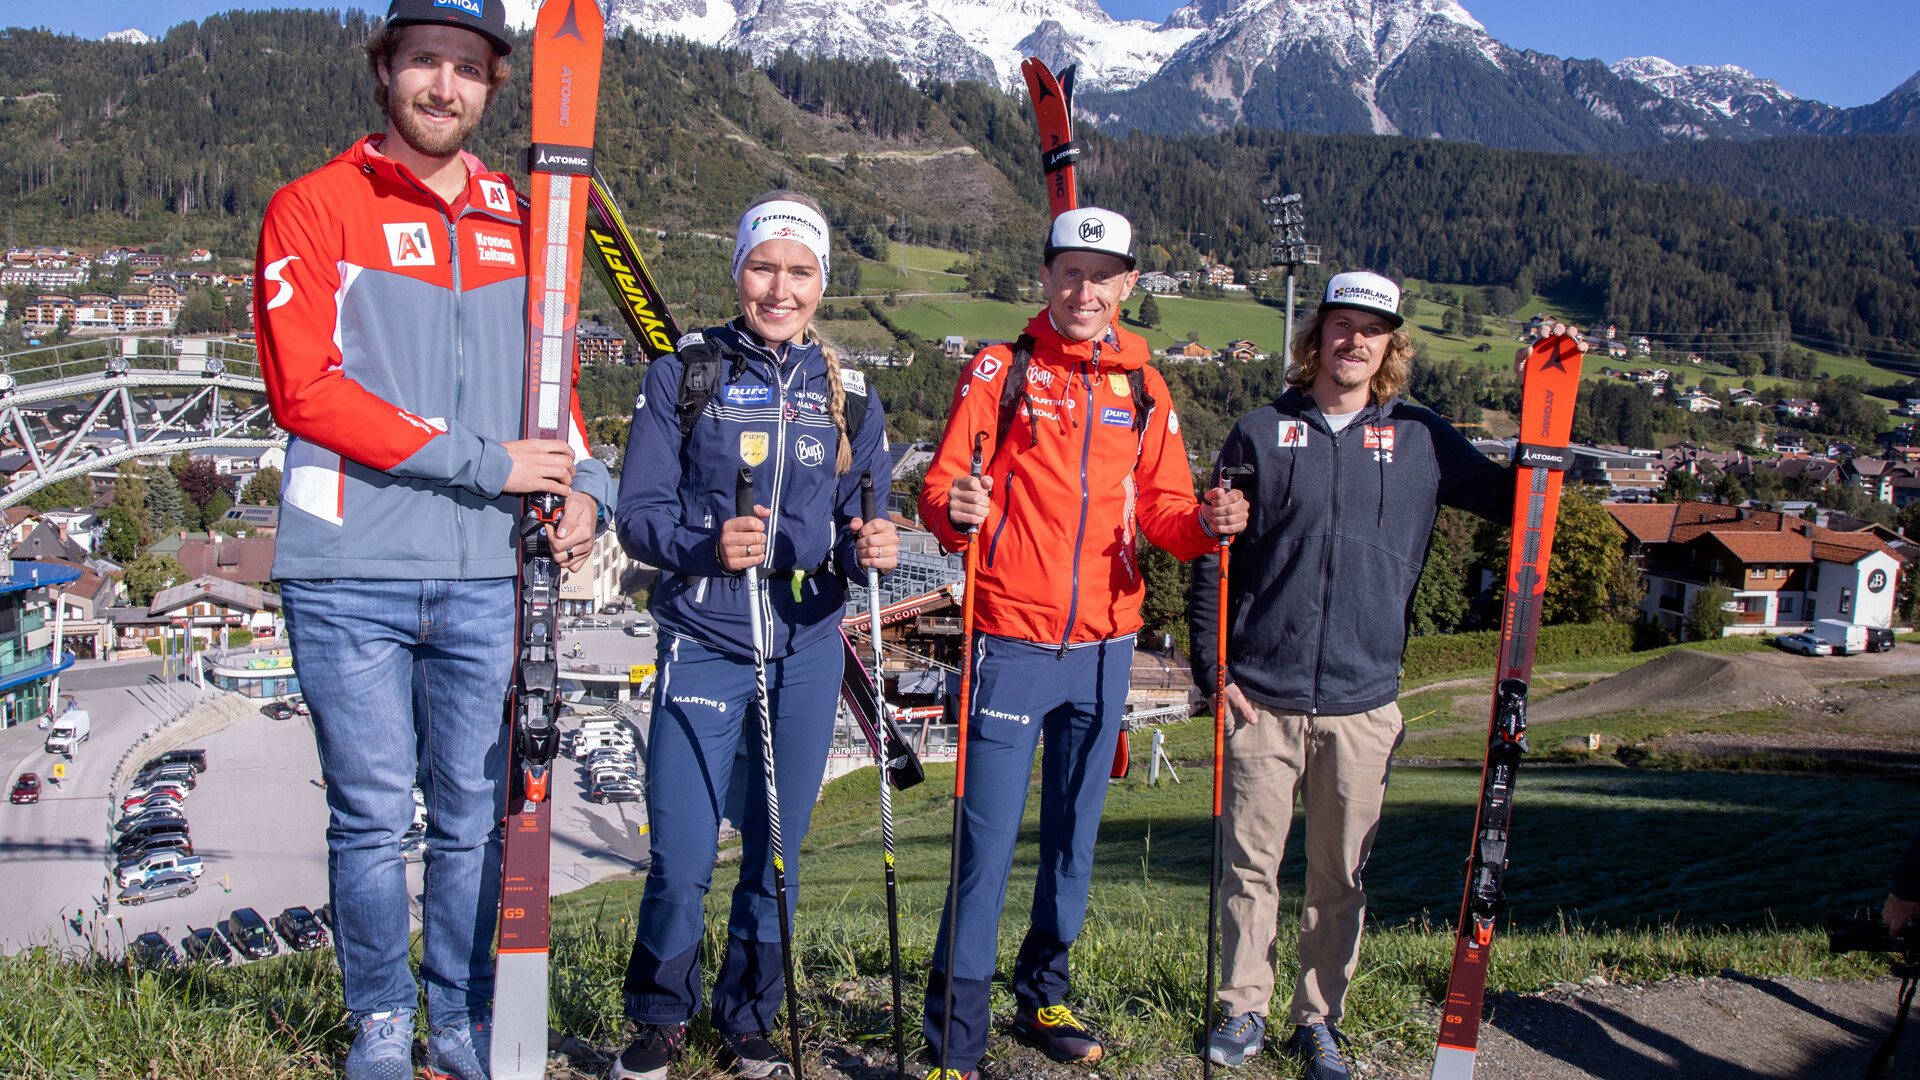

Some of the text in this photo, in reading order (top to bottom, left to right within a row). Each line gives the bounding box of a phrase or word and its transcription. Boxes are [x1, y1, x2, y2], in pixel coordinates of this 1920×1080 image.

[559, 64, 572, 127] ATOMIC
[548, 155, 588, 166] ATOMIC
[1056, 148, 1080, 161] ATOMIC
[1051, 134, 1064, 198] AMIC
[490, 187, 504, 204] A1
[762, 214, 821, 236] STEINBACHER
[397, 228, 427, 260] A1
[475, 232, 512, 249] Kronen
[478, 247, 515, 265] Zeitung
[590, 229, 675, 353] DYNAFIT
[1344, 287, 1392, 302] CASABLANCA
[532, 341, 541, 392] REDSTER
[728, 388, 768, 396] pure
[1033, 408, 1060, 421] KOHLA
[1105, 410, 1129, 418] pure
[1541, 389, 1554, 438] ATOMIC
[1531, 453, 1563, 462] ATOMIC
[854, 607, 922, 631] tee.com
[1505, 602, 1515, 641] REDSTER
[961, 634, 970, 681] ATOMIC
[1216, 664, 1225, 709] ATOMIC
[672, 696, 717, 707] MARTINI
[980, 708, 1020, 722] MARTINI
[829, 746, 860, 754] aurant
[504, 908, 525, 919] G9
[1446, 1014, 1463, 1024] G9
